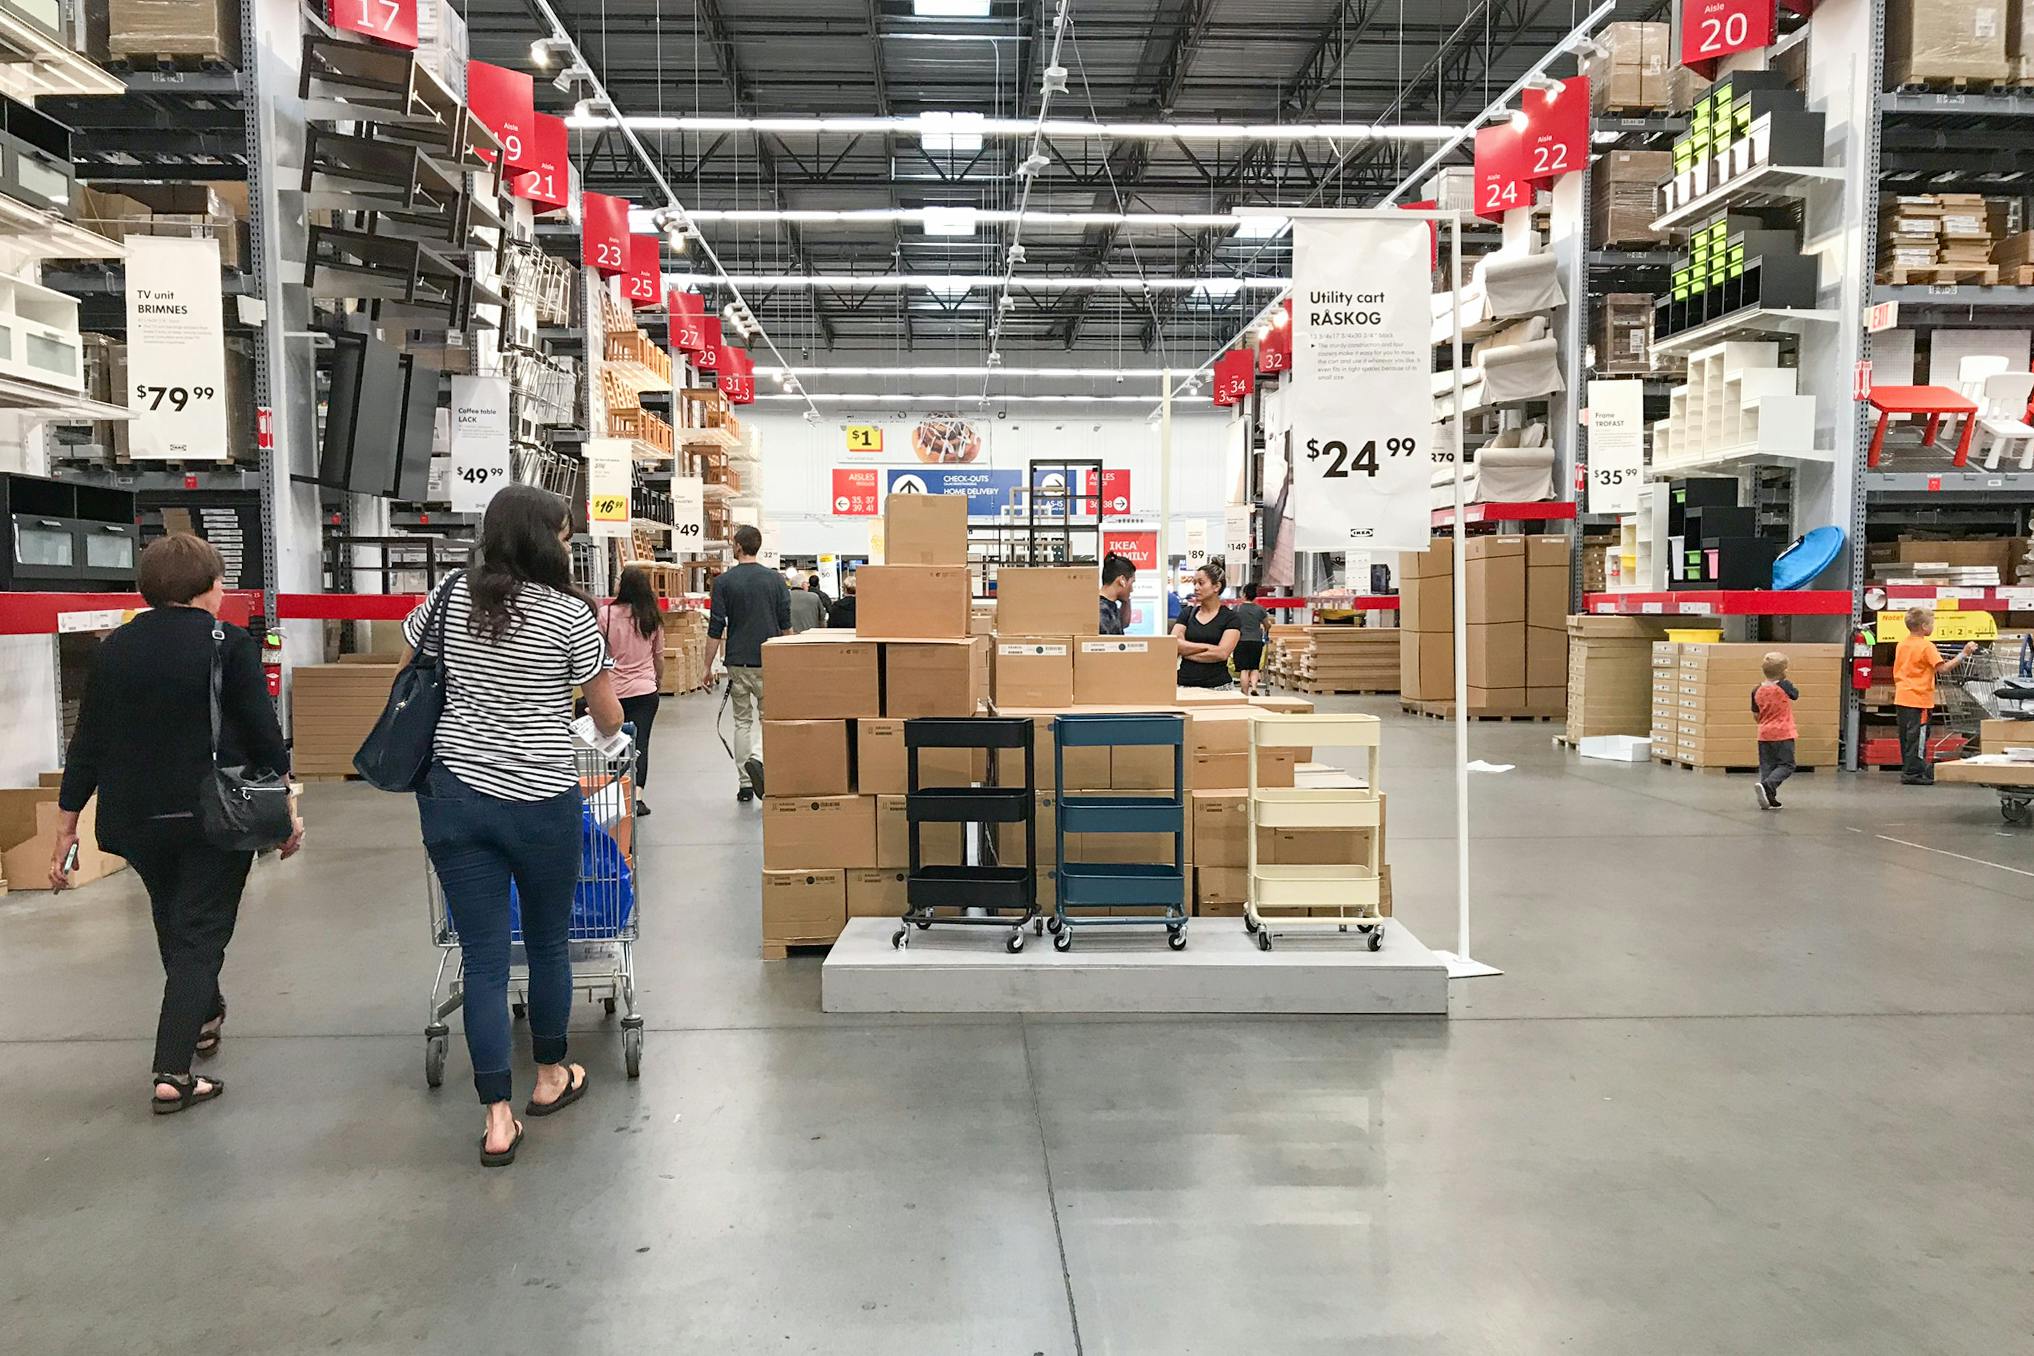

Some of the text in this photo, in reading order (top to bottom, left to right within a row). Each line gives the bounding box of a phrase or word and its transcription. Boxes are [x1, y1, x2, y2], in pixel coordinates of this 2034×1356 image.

[357, 0, 400, 32] 17
[1704, 3, 1725, 14] Aisle
[1700, 12, 1748, 53] 20
[1537, 135, 1553, 143] Aisle
[1533, 143, 1568, 173] 22
[527, 171, 556, 198] 21
[1486, 181, 1518, 208] 24
[597, 243, 622, 266] 23
[137, 290, 174, 300] TV unit
[631, 277, 653, 298] 25
[1310, 291, 1385, 306] Utility cart
[138, 304, 188, 314] BRIMNES
[1310, 309, 1382, 326] RÅSKOG
[680, 329, 698, 346] 27
[699, 351, 716, 365] 29
[1265, 353, 1283, 369] 32
[726, 377, 740, 391] 31
[1230, 380, 1246, 393] 34
[136, 384, 214, 412] $79 99
[852, 430, 872, 446] $1
[1306, 437, 1416, 478] $24 99
[457, 466, 504, 484] $49 99
[848, 472, 875, 480] AISLES
[1089, 472, 1116, 480] AILES
[1594, 468, 1638, 485] $35 99
[966, 487, 1000, 495] DELIVERY
[595, 500, 614, 513] $16
[675, 523, 699, 536] $49
[1351, 528, 1374, 538] IKEA
[1109, 541, 1137, 550] IKEA
[1112, 552, 1149, 560] AMILY
